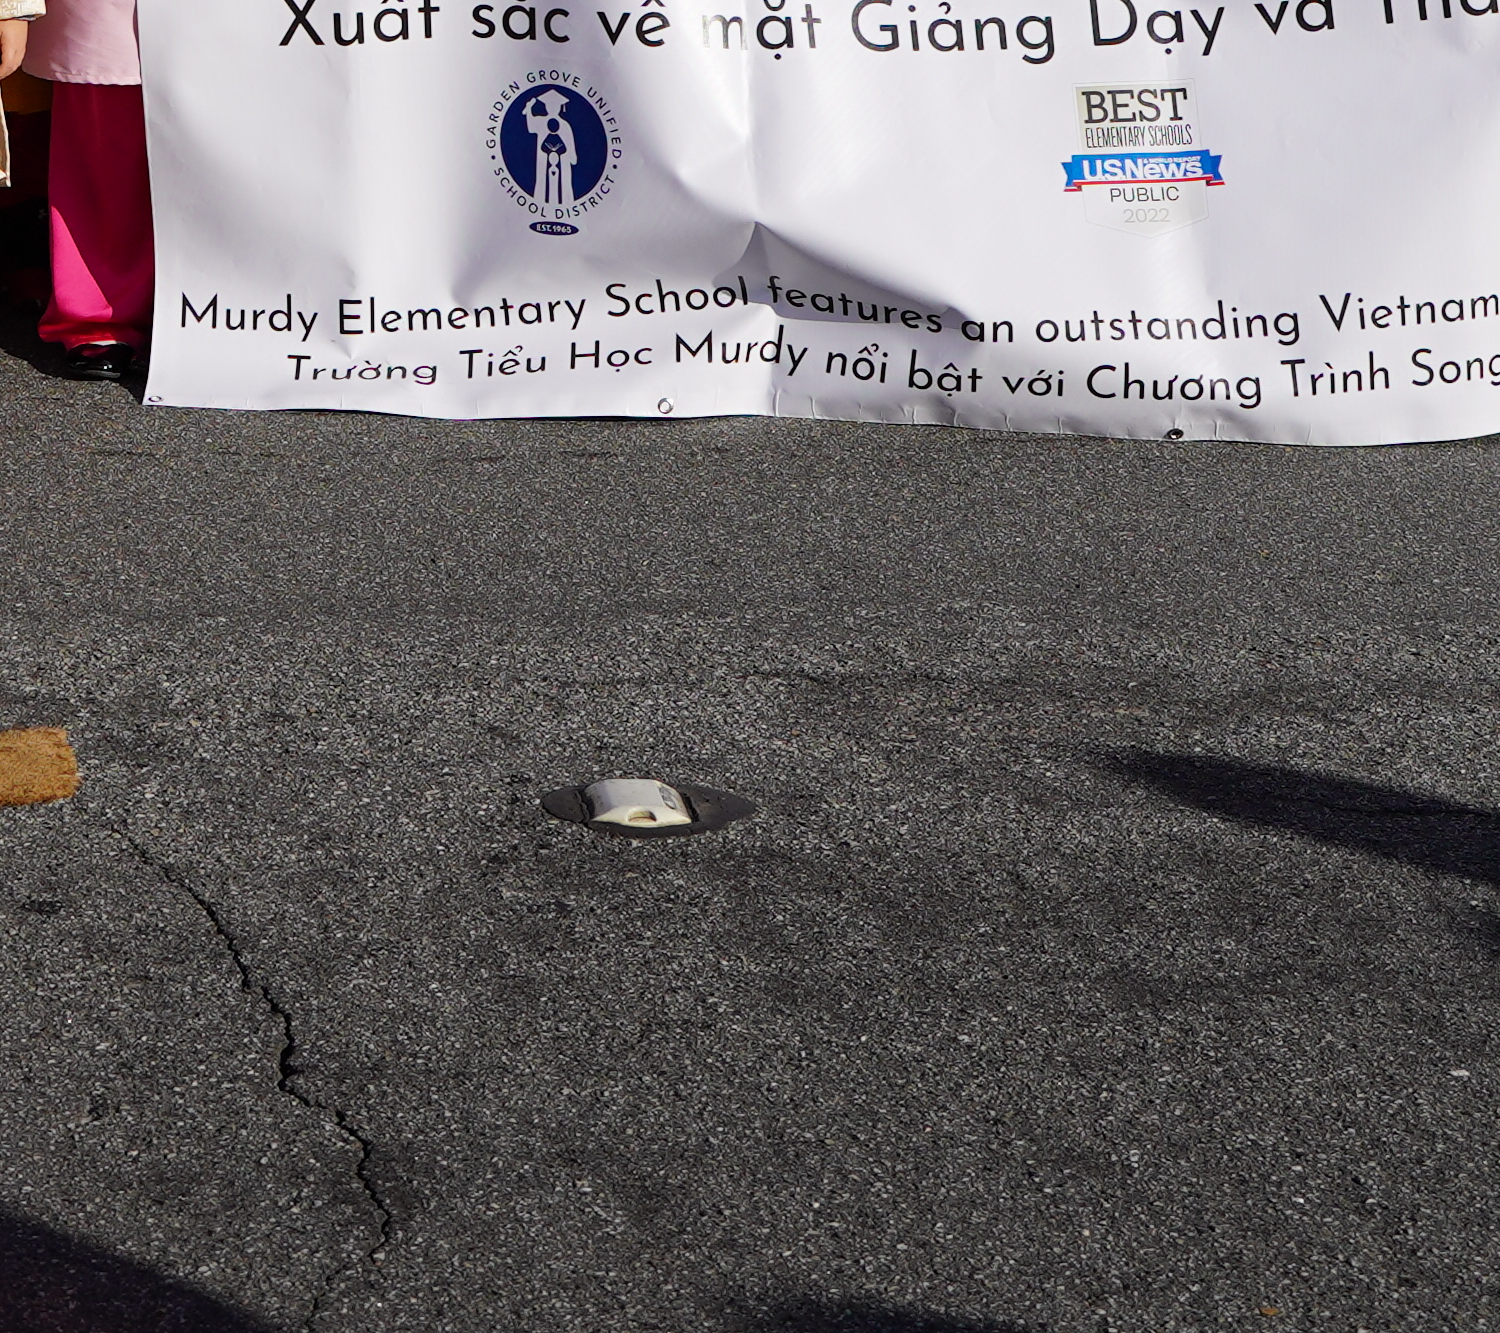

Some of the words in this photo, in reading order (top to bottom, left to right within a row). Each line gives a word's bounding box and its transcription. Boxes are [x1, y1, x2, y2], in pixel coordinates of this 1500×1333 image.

[486, 81, 520, 149] GARDEN
[526, 70, 581, 87] GROVE
[587, 87, 622, 159] UNIFIED
[1081, 88, 1187, 124] BEST
[1085, 126, 1145, 148] ELEMENTARY
[1148, 124, 1192, 146] SCHOOLS
[494, 167, 546, 218] SCHOOL
[555, 175, 615, 220] DISTRICT
[1110, 186, 1180, 203] PUBLIC
[1123, 208, 1170, 223] 2022
[181, 292, 318, 342] Murdy
[338, 292, 587, 335] Elementary
[606, 275, 749, 319] School
[767, 274, 943, 334] features
[962, 316, 1014, 344] an
[1036, 300, 1299, 346] outstanding
[287, 355, 437, 385] Trường
[459, 345, 546, 379] Tiểu
[570, 340, 652, 369] Học
[674, 324, 808, 377] Murdy
[826, 343, 888, 383] nổi
[908, 349, 983, 397] bật
[1001, 370, 1064, 397] với
[1087, 362, 1261, 409] Chương
[1280, 351, 1389, 397] Trình
